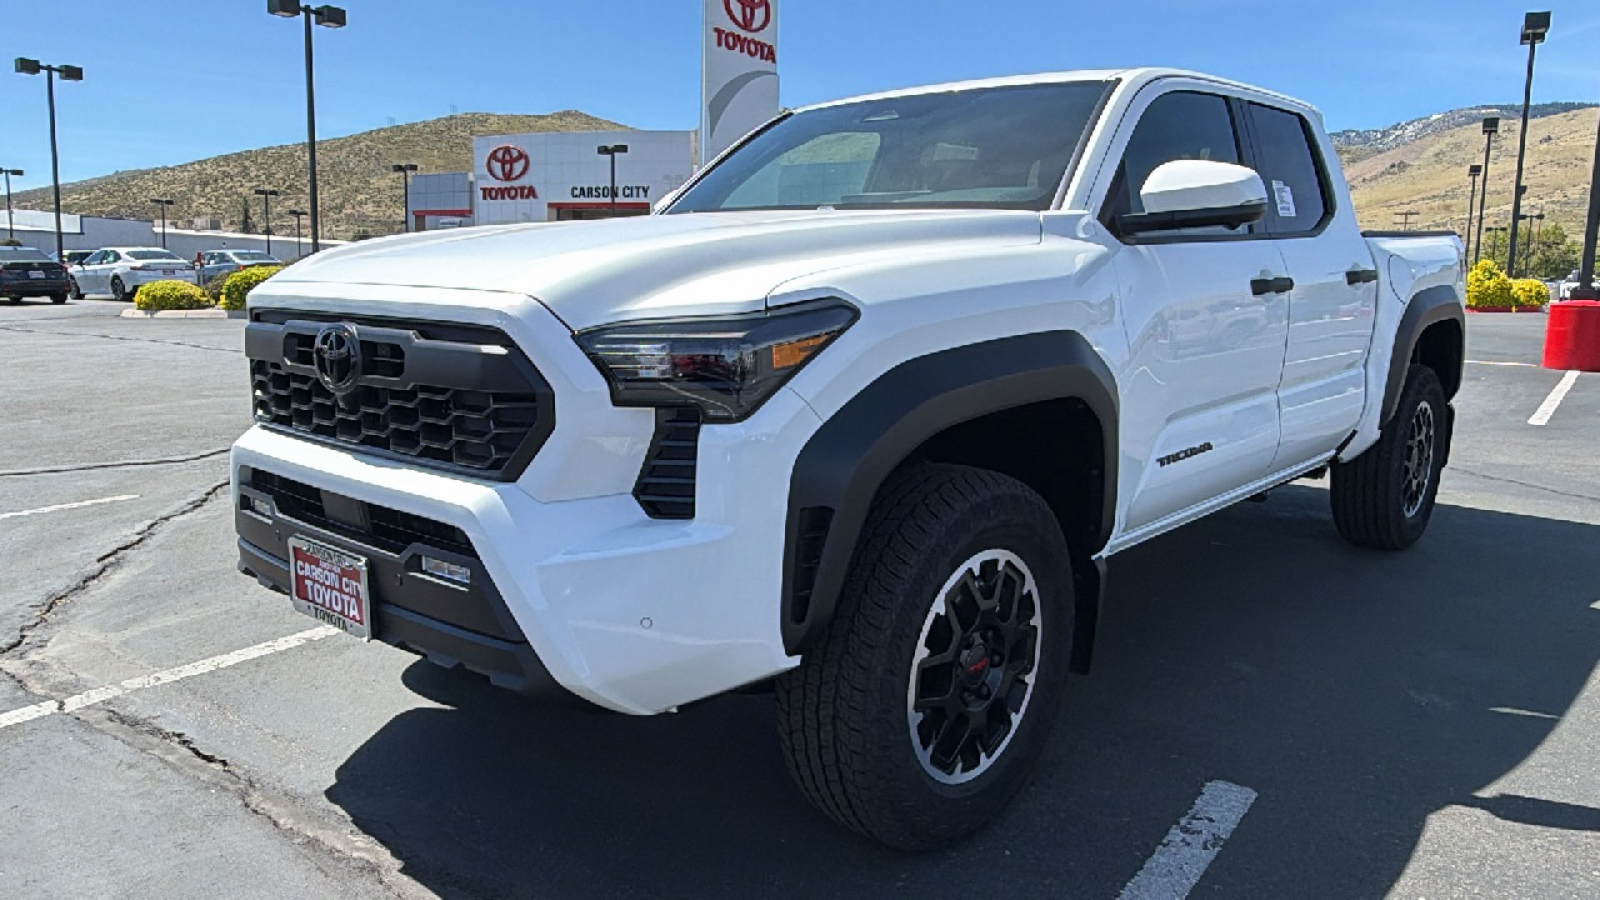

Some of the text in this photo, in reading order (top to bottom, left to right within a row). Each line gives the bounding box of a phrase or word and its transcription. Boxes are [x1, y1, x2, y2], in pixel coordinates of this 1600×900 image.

[713, 27, 776, 64] TOYOTA
[480, 186, 538, 200] TOYOTA
[571, 186, 650, 198] CARSON CITY
[296, 560, 362, 599] CARSON CITY
[305, 579, 360, 621] TOYOTA
[314, 606, 348, 631] TOYOTA
